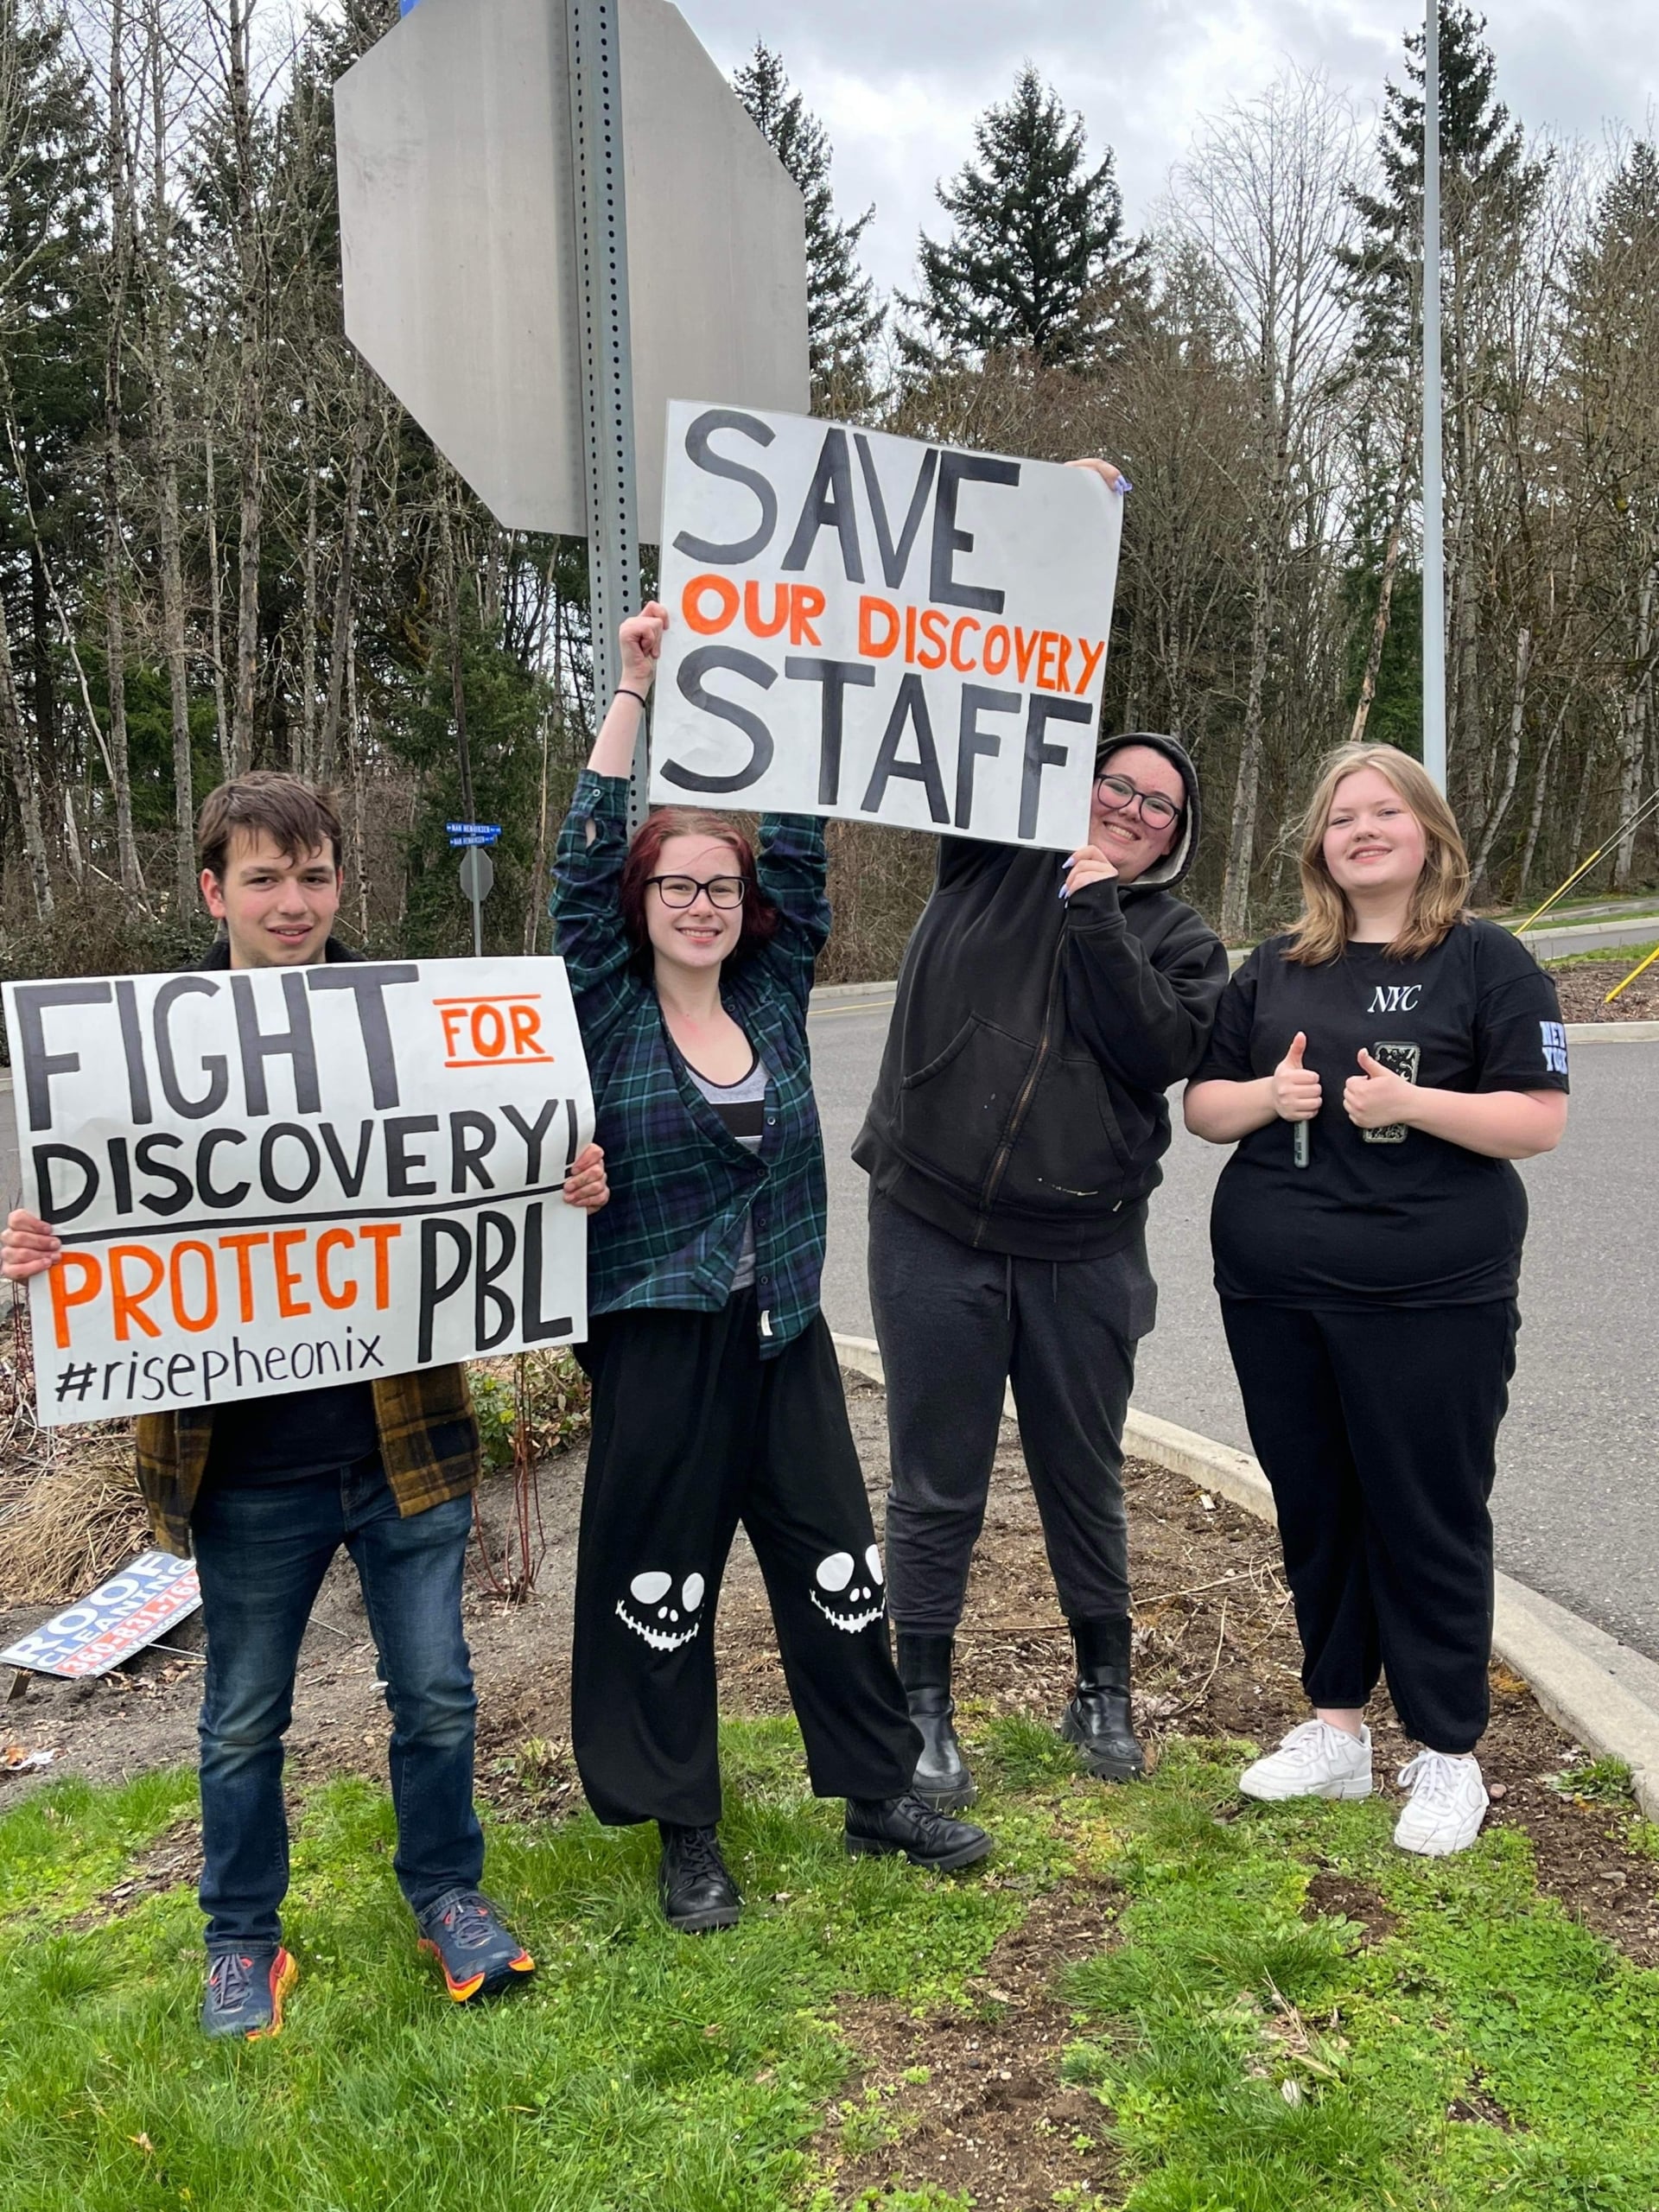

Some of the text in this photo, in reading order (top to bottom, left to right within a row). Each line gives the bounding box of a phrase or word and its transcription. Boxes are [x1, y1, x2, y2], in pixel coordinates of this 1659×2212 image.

[672, 410, 1020, 614] SAVE
[682, 574, 1105, 695] OUR DISCOVERY
[660, 645, 1093, 839] STAFF
[14, 964, 545, 1131] FIGHT FOR
[1367, 984, 1421, 1013] NYC
[32, 1099, 578, 1225] DISCOVERY!
[48, 1203, 573, 1363] PROTECT PBL
[54, 1326, 385, 1402] #risepheonix
[3, 1553, 165, 1663] ROOF
[37, 1559, 197, 1667] CLEANING
